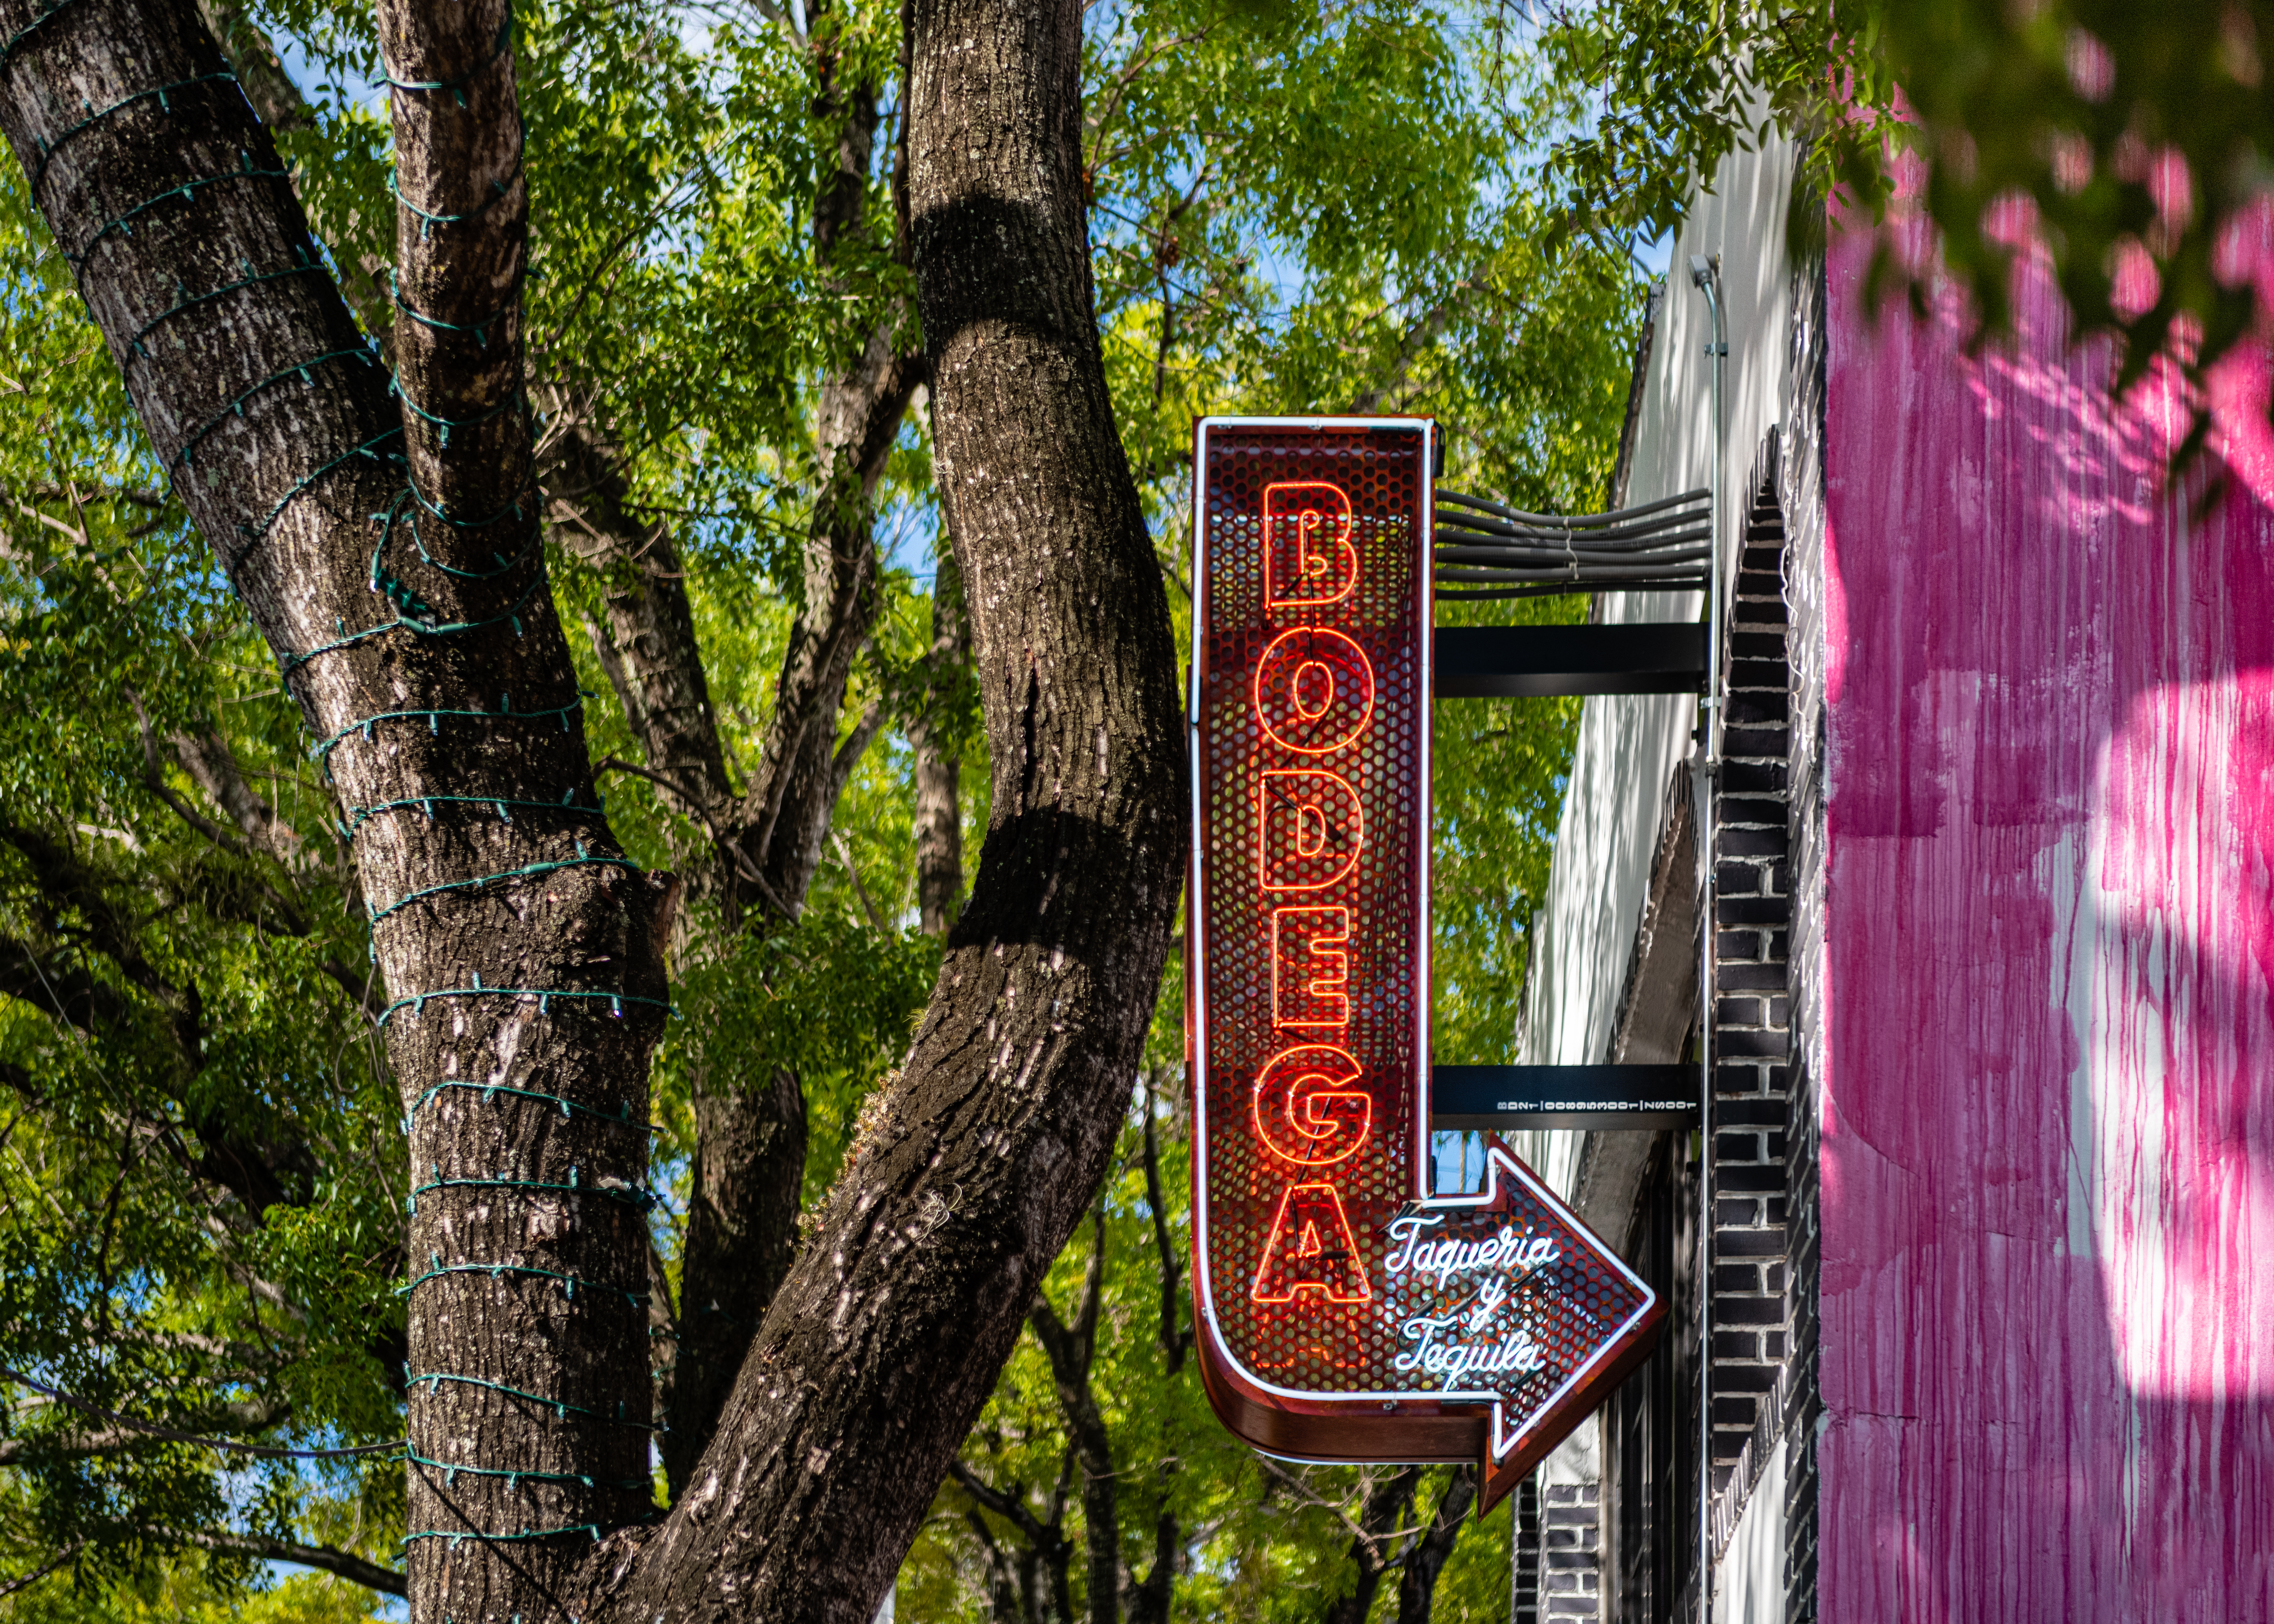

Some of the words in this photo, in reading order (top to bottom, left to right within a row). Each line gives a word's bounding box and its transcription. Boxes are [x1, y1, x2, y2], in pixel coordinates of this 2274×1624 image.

[1251, 481, 1375, 1302] BODEGA
[1469, 1276, 1508, 1332] y
[1394, 1316, 1547, 1393] Tequila
